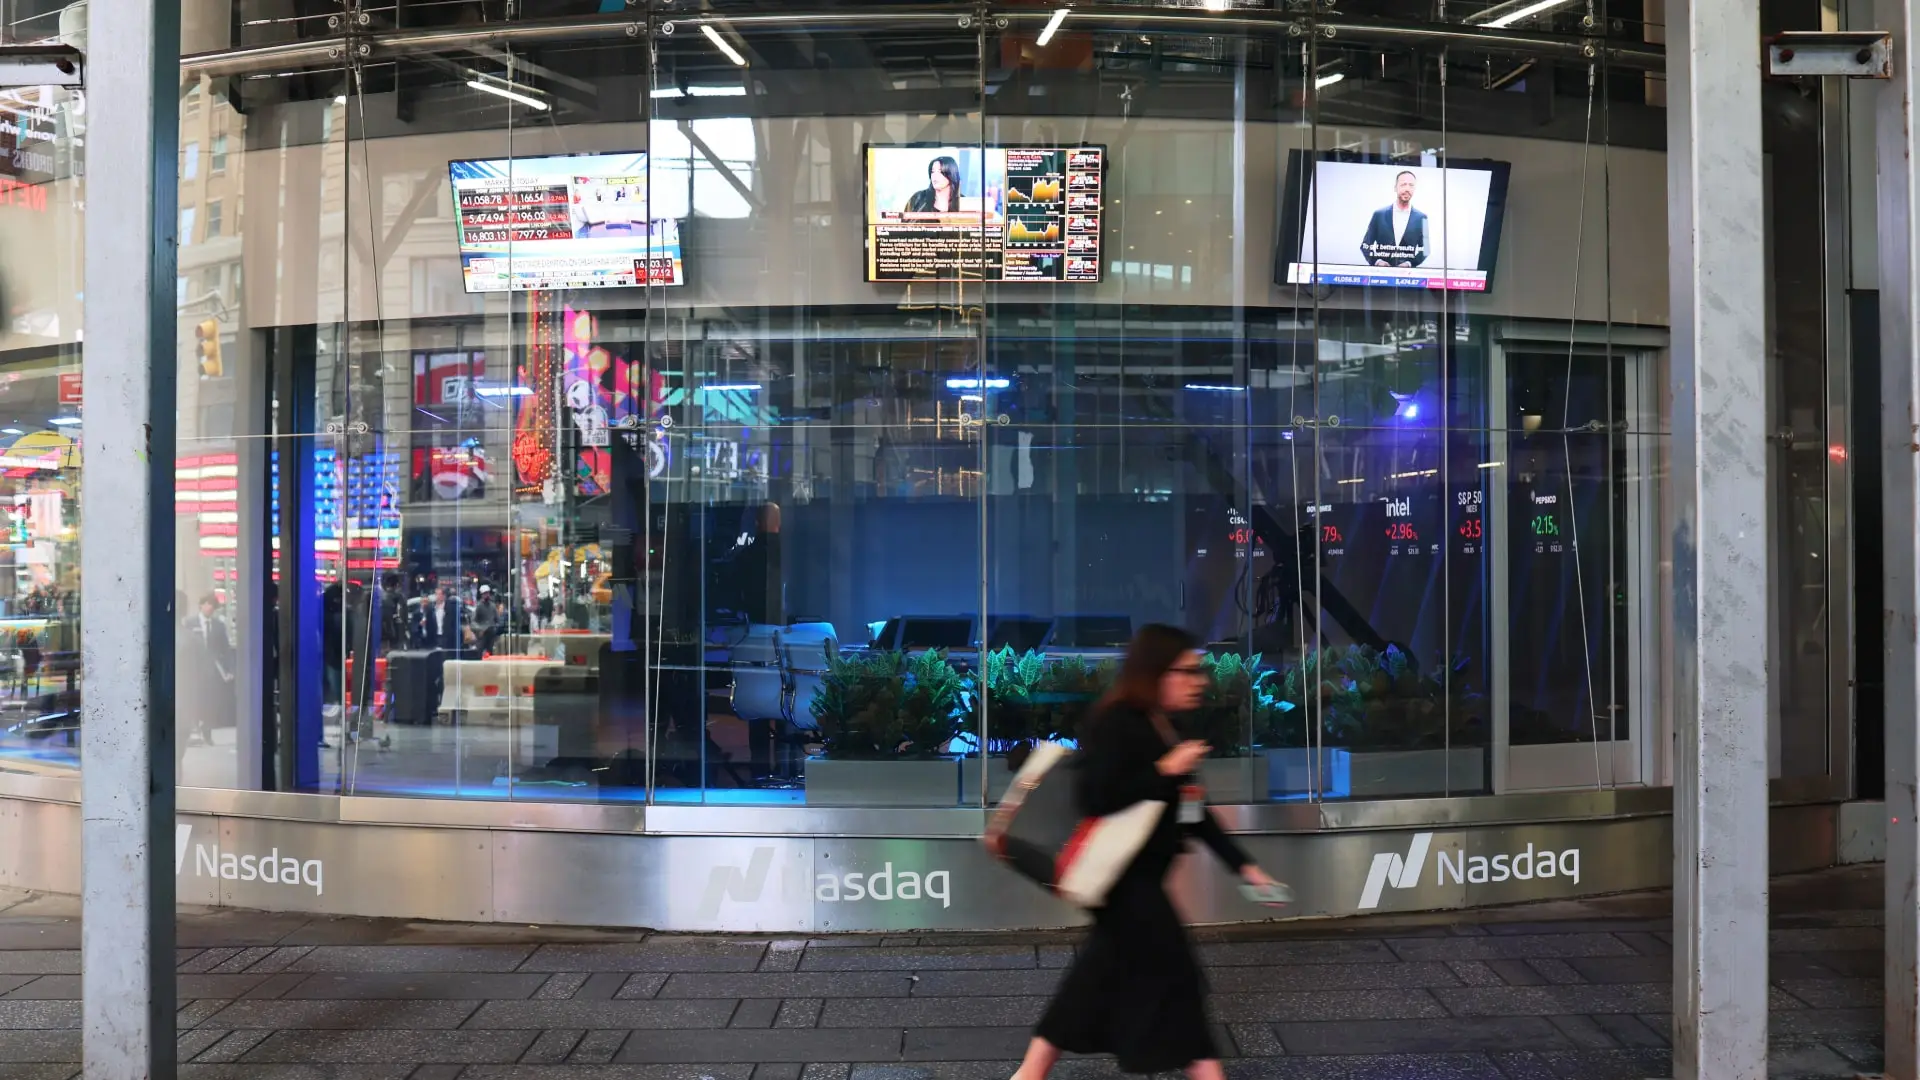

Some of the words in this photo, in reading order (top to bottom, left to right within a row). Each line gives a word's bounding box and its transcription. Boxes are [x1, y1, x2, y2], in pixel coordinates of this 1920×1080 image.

[462, 195, 502, 206] 41,058.78
[514, 193, 544, 205] 1,166.54
[469, 213, 504, 225] 5,474.94
[517, 212, 545, 221] 196.03
[467, 231, 506, 243] 16,803.13
[518, 230, 548, 240] 797.92
[1458, 492, 1472, 505] S&P
[1473, 491, 1482, 504] 50
[1535, 495, 1556, 505] PEPSICO
[1229, 517, 1248, 525] CIS
[1536, 516, 1559, 536] 2.15%
[1391, 523, 1418, 540] 2.96%
[1438, 842, 1580, 885] Nasdaq
[196, 844, 323, 897] Nasdaq
